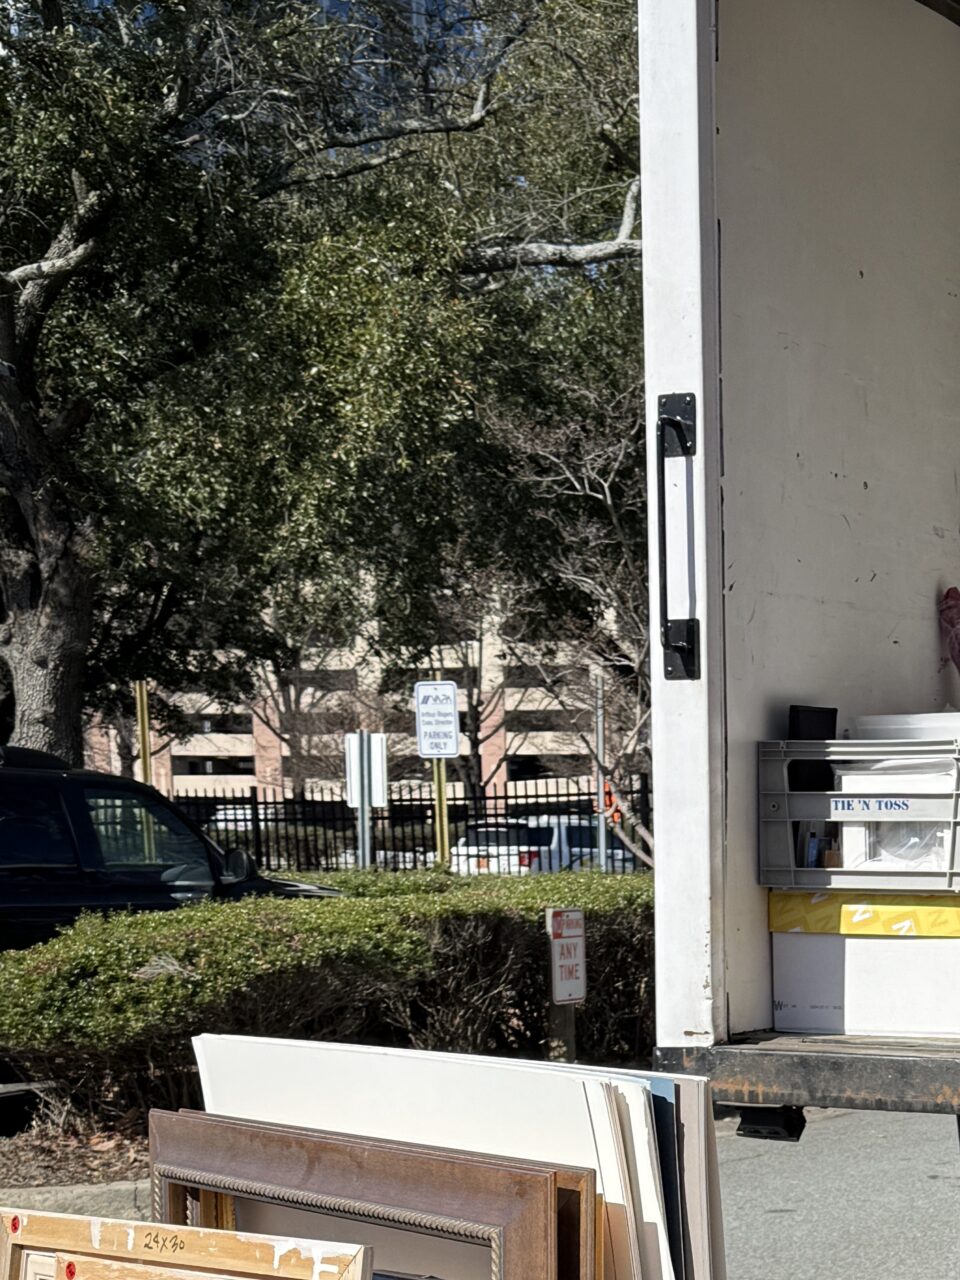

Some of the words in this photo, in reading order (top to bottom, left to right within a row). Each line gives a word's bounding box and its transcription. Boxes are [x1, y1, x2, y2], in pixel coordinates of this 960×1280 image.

[833, 799, 855, 811] TIE
[857, 799, 871, 811] 'N
[876, 799, 909, 811] TOSS
[560, 943, 578, 960] ANY
[559, 963, 580, 981] TIME
